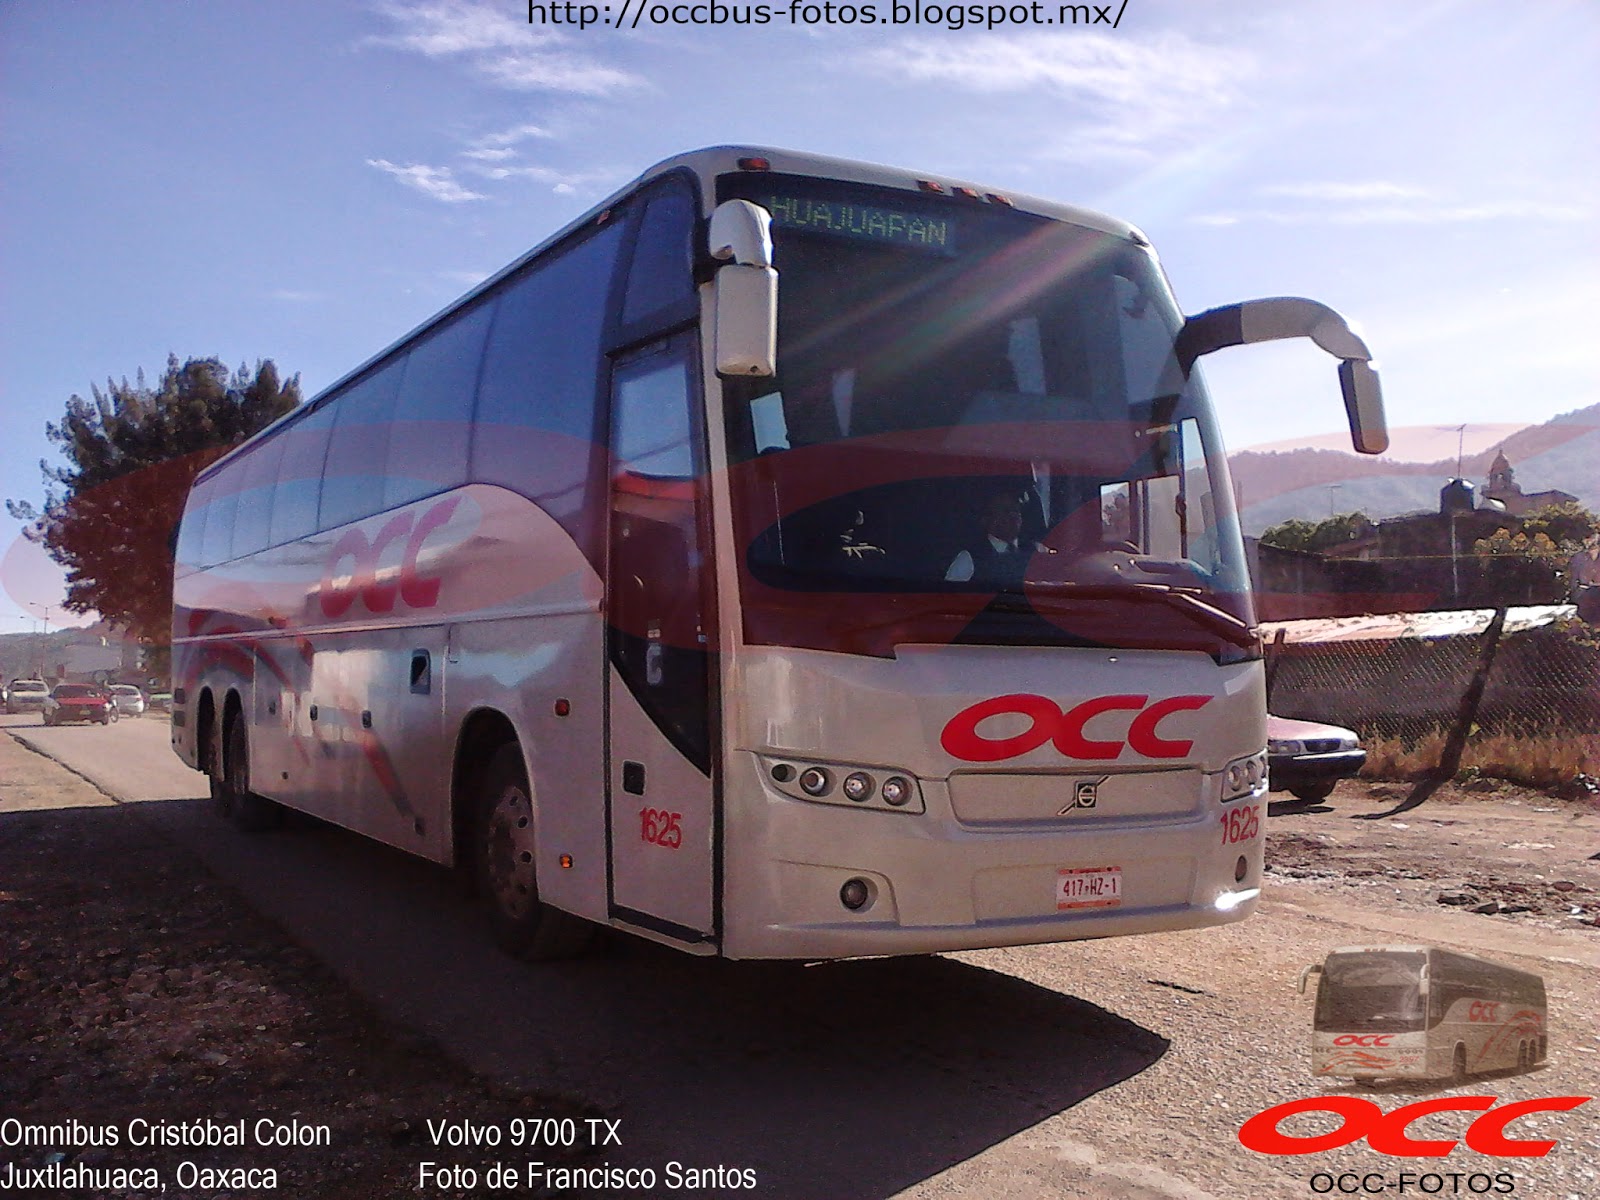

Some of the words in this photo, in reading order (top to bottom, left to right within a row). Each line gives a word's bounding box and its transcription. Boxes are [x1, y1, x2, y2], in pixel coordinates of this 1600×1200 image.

[769, 195, 947, 246] HUAJUAPAN
[320, 495, 463, 617] OCC
[940, 693, 1215, 762] OCC
[639, 806, 682, 849] 1625
[1220, 806, 1259, 845] 1625
